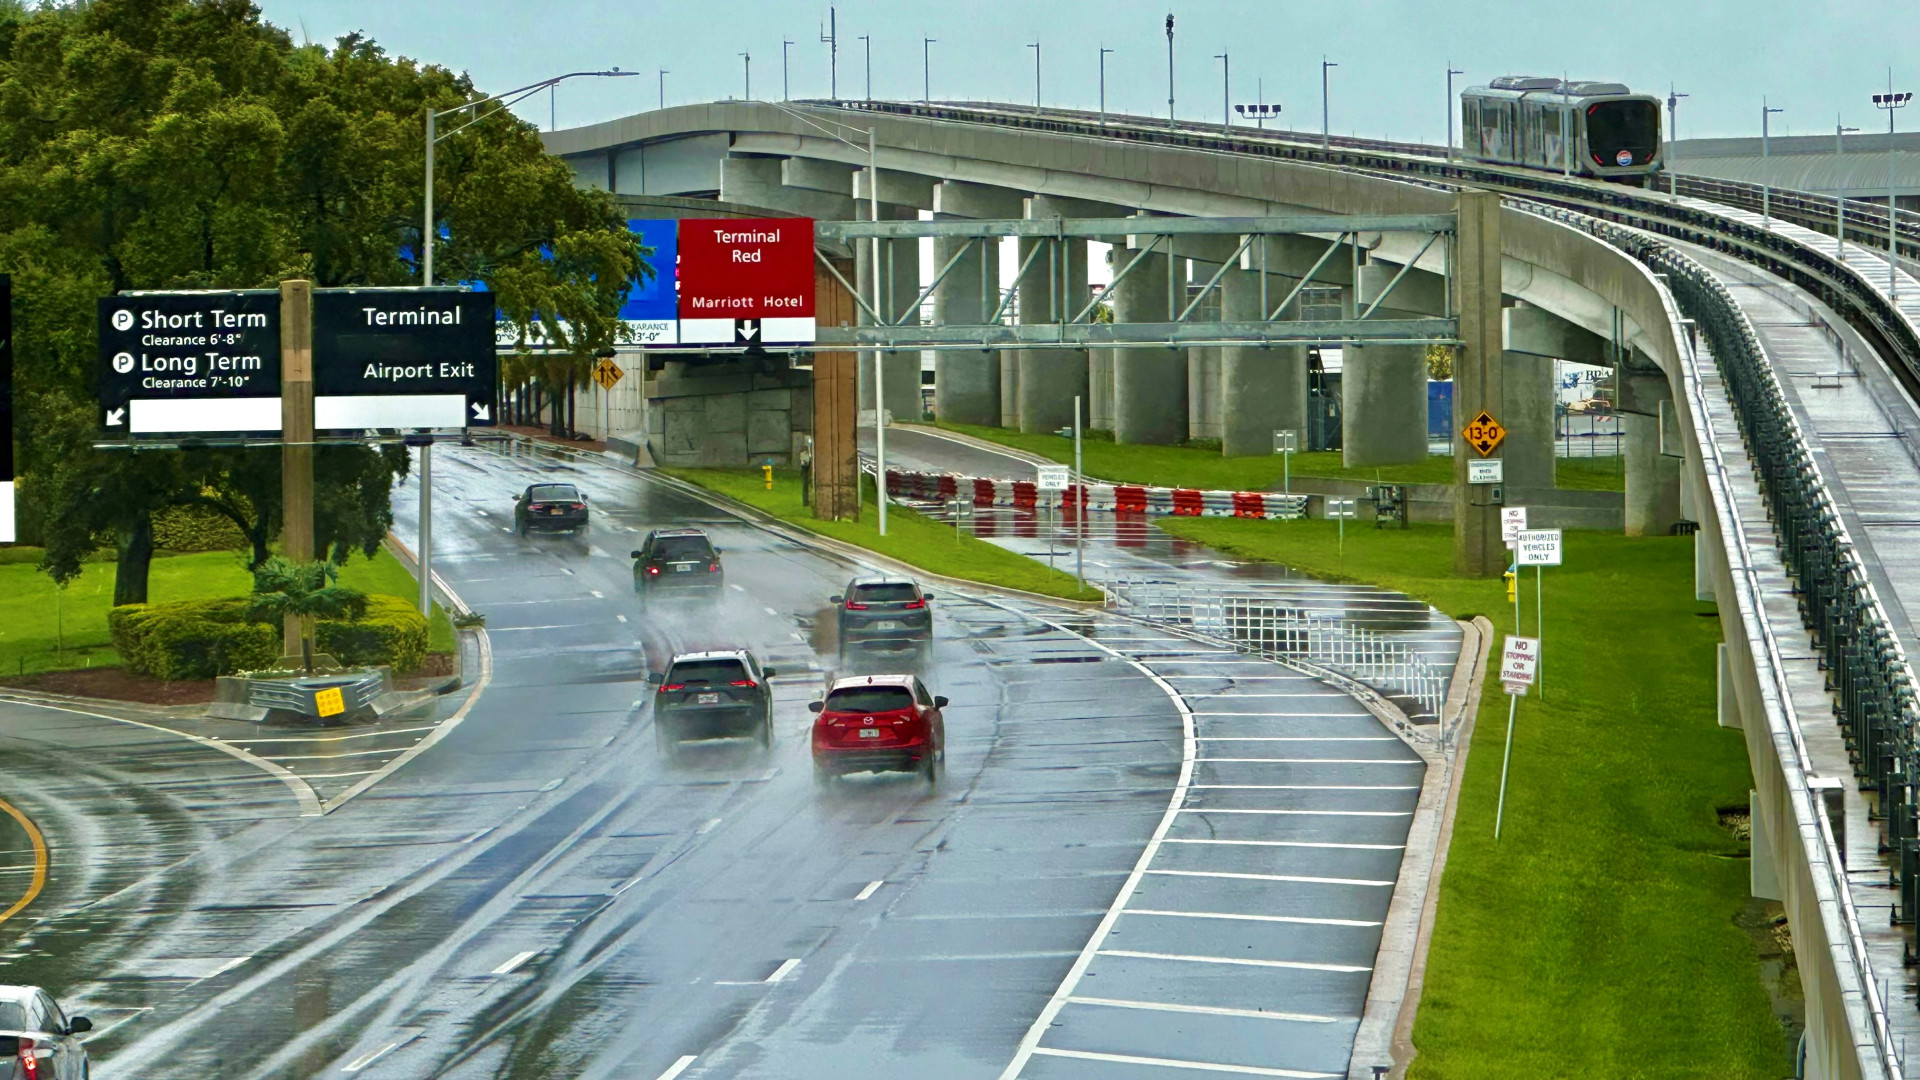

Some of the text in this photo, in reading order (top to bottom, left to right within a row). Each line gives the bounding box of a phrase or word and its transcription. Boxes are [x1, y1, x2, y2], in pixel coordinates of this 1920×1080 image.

[713, 228, 780, 243] Terminal
[732, 248, 761, 263] Red
[692, 294, 803, 308] Marriott Hotel
[141, 309, 203, 329] Short
[210, 309, 266, 328] Term
[362, 305, 461, 325] Terminal
[141, 333, 242, 346] Clearance 6'-8"
[141, 353, 197, 376] Long
[205, 352, 261, 370] Term
[363, 361, 475, 382] Airport Exit
[142, 375, 250, 389] Clearance 7'-10"
[1518, 533, 1559, 541] AUTHORIZED
[1523, 543, 1555, 551] VEHICLES
[1528, 553, 1550, 561] ONLY
[1514, 640, 1528, 650] NO
